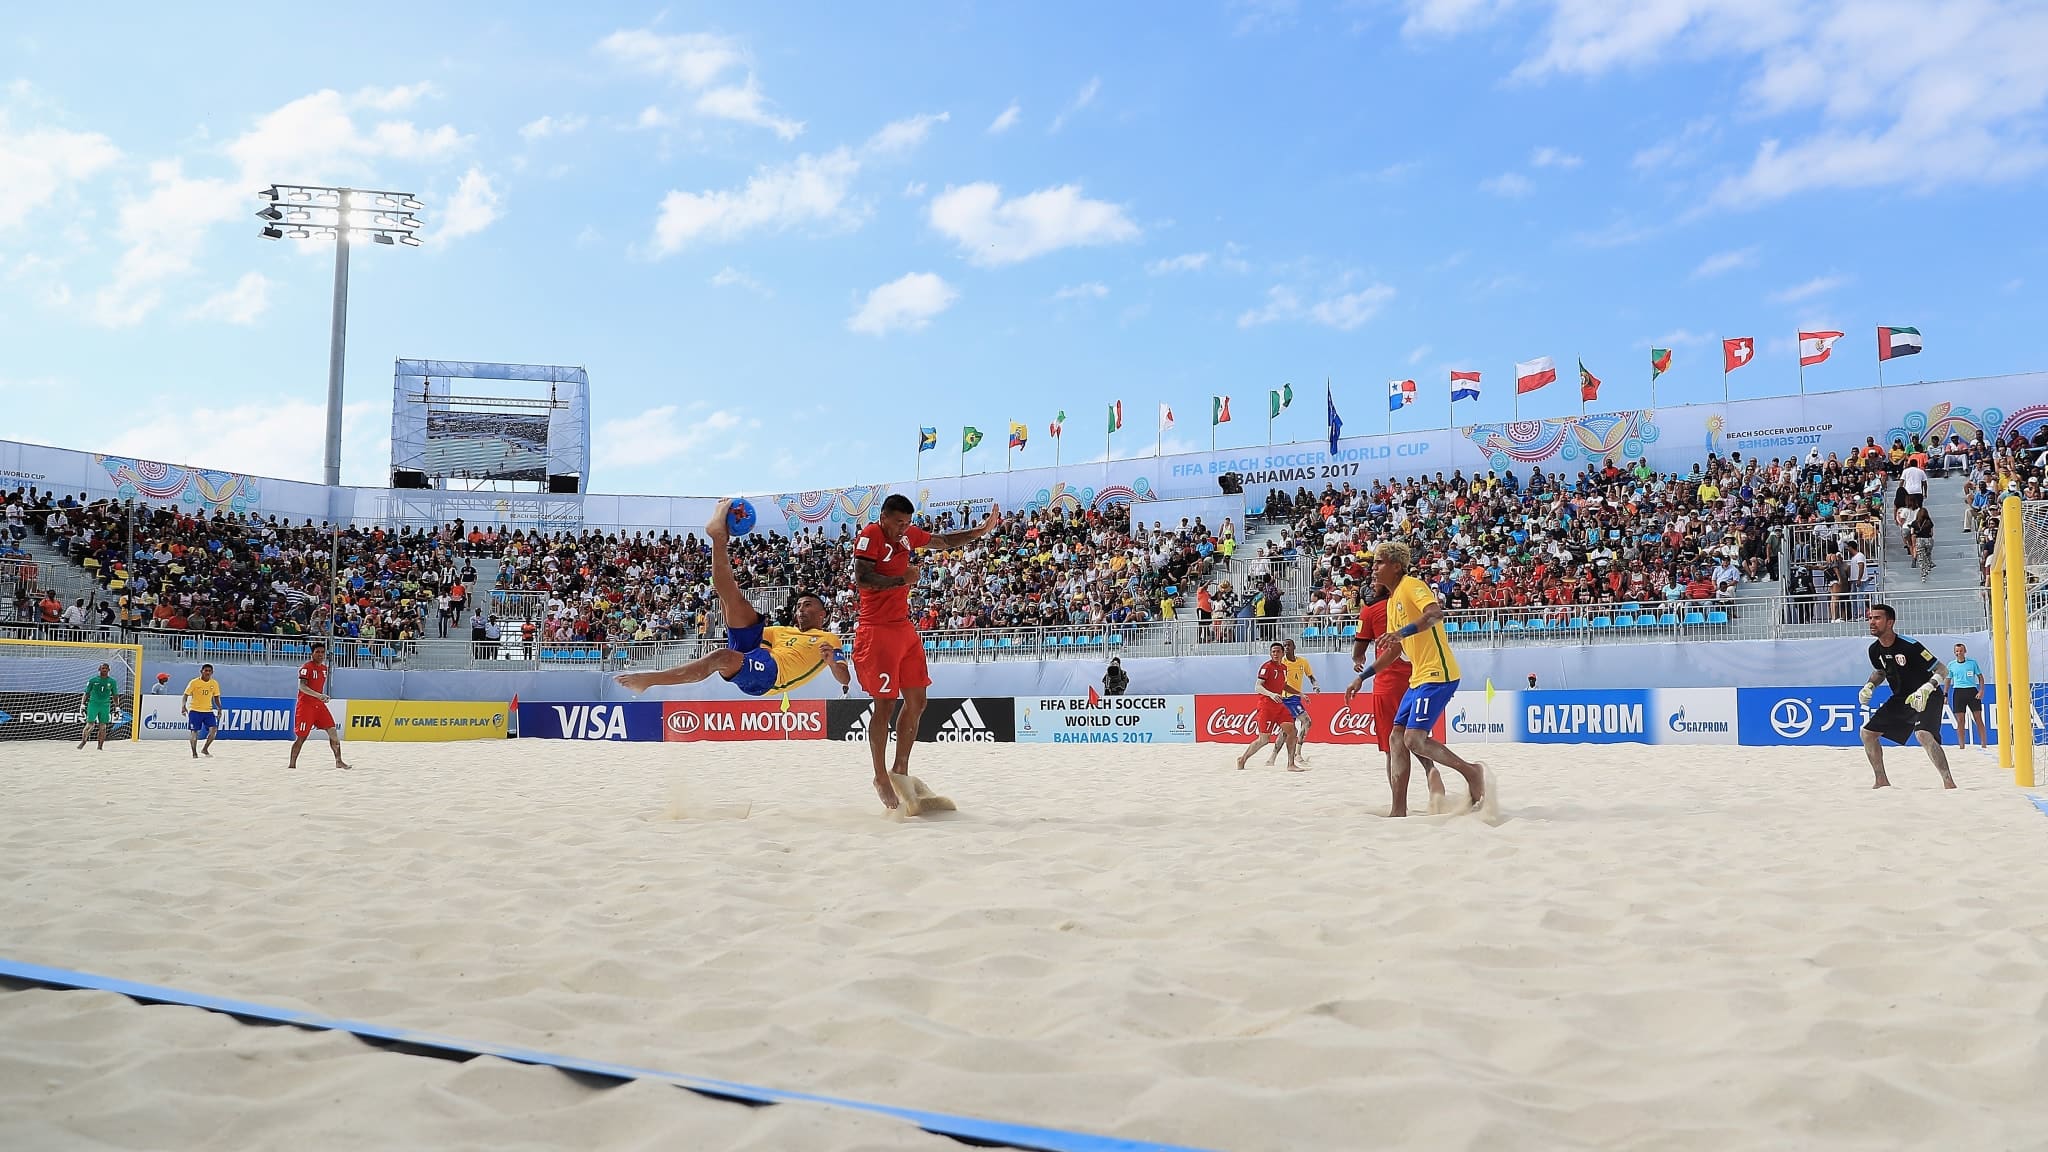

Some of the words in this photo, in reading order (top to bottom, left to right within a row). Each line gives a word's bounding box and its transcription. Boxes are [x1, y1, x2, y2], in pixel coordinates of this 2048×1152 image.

[1726, 431, 1752, 439] BEACH
[1754, 428, 1784, 436] SOCCER
[1785, 425, 1815, 434] WORLD
[1796, 434, 1821, 444] 2017
[1172, 464, 1203, 476] FIFA
[1208, 458, 1258, 474] BEACH
[1265, 451, 1325, 468] SOCCER
[1331, 446, 1391, 462] WORLD
[1397, 442, 1430, 456] CUP
[4, 470, 30, 478] WORLD
[1236, 467, 1316, 484] BAHAMAS
[1321, 463, 1359, 478] 2017
[882, 543, 894, 562] 2
[754, 661, 765, 671] 8
[1274, 669, 1278, 679] 7
[879, 672, 892, 693] 2
[1040, 699, 1066, 710] FIFA
[1069, 699, 1112, 710] BEACH
[1115, 698, 1166, 710] SOCCER
[1415, 698, 1430, 714] 11
[352, 715, 381, 727] FIFA
[394, 718, 410, 726] MY
[412, 717, 438, 726] GAME
[440, 717, 448, 726] IS
[450, 717, 468, 726] FAIR
[469, 718, 490, 726] PLAY
[551, 705, 628, 739] VISA
[672, 714, 695, 729] KIA
[704, 712, 735, 731] KIA
[741, 712, 822, 732] MOTORS
[1065, 716, 1111, 727] WORLD
[1115, 715, 1140, 726] CUP
[1527, 704, 1644, 734] GAZPROM
[1467, 723, 1504, 733] GAZPROM
[1686, 721, 1728, 733] GAZPROM
[936, 728, 995, 742] adidas
[1053, 732, 1118, 743] BAHAMAS
[1122, 732, 1153, 743] 2017
